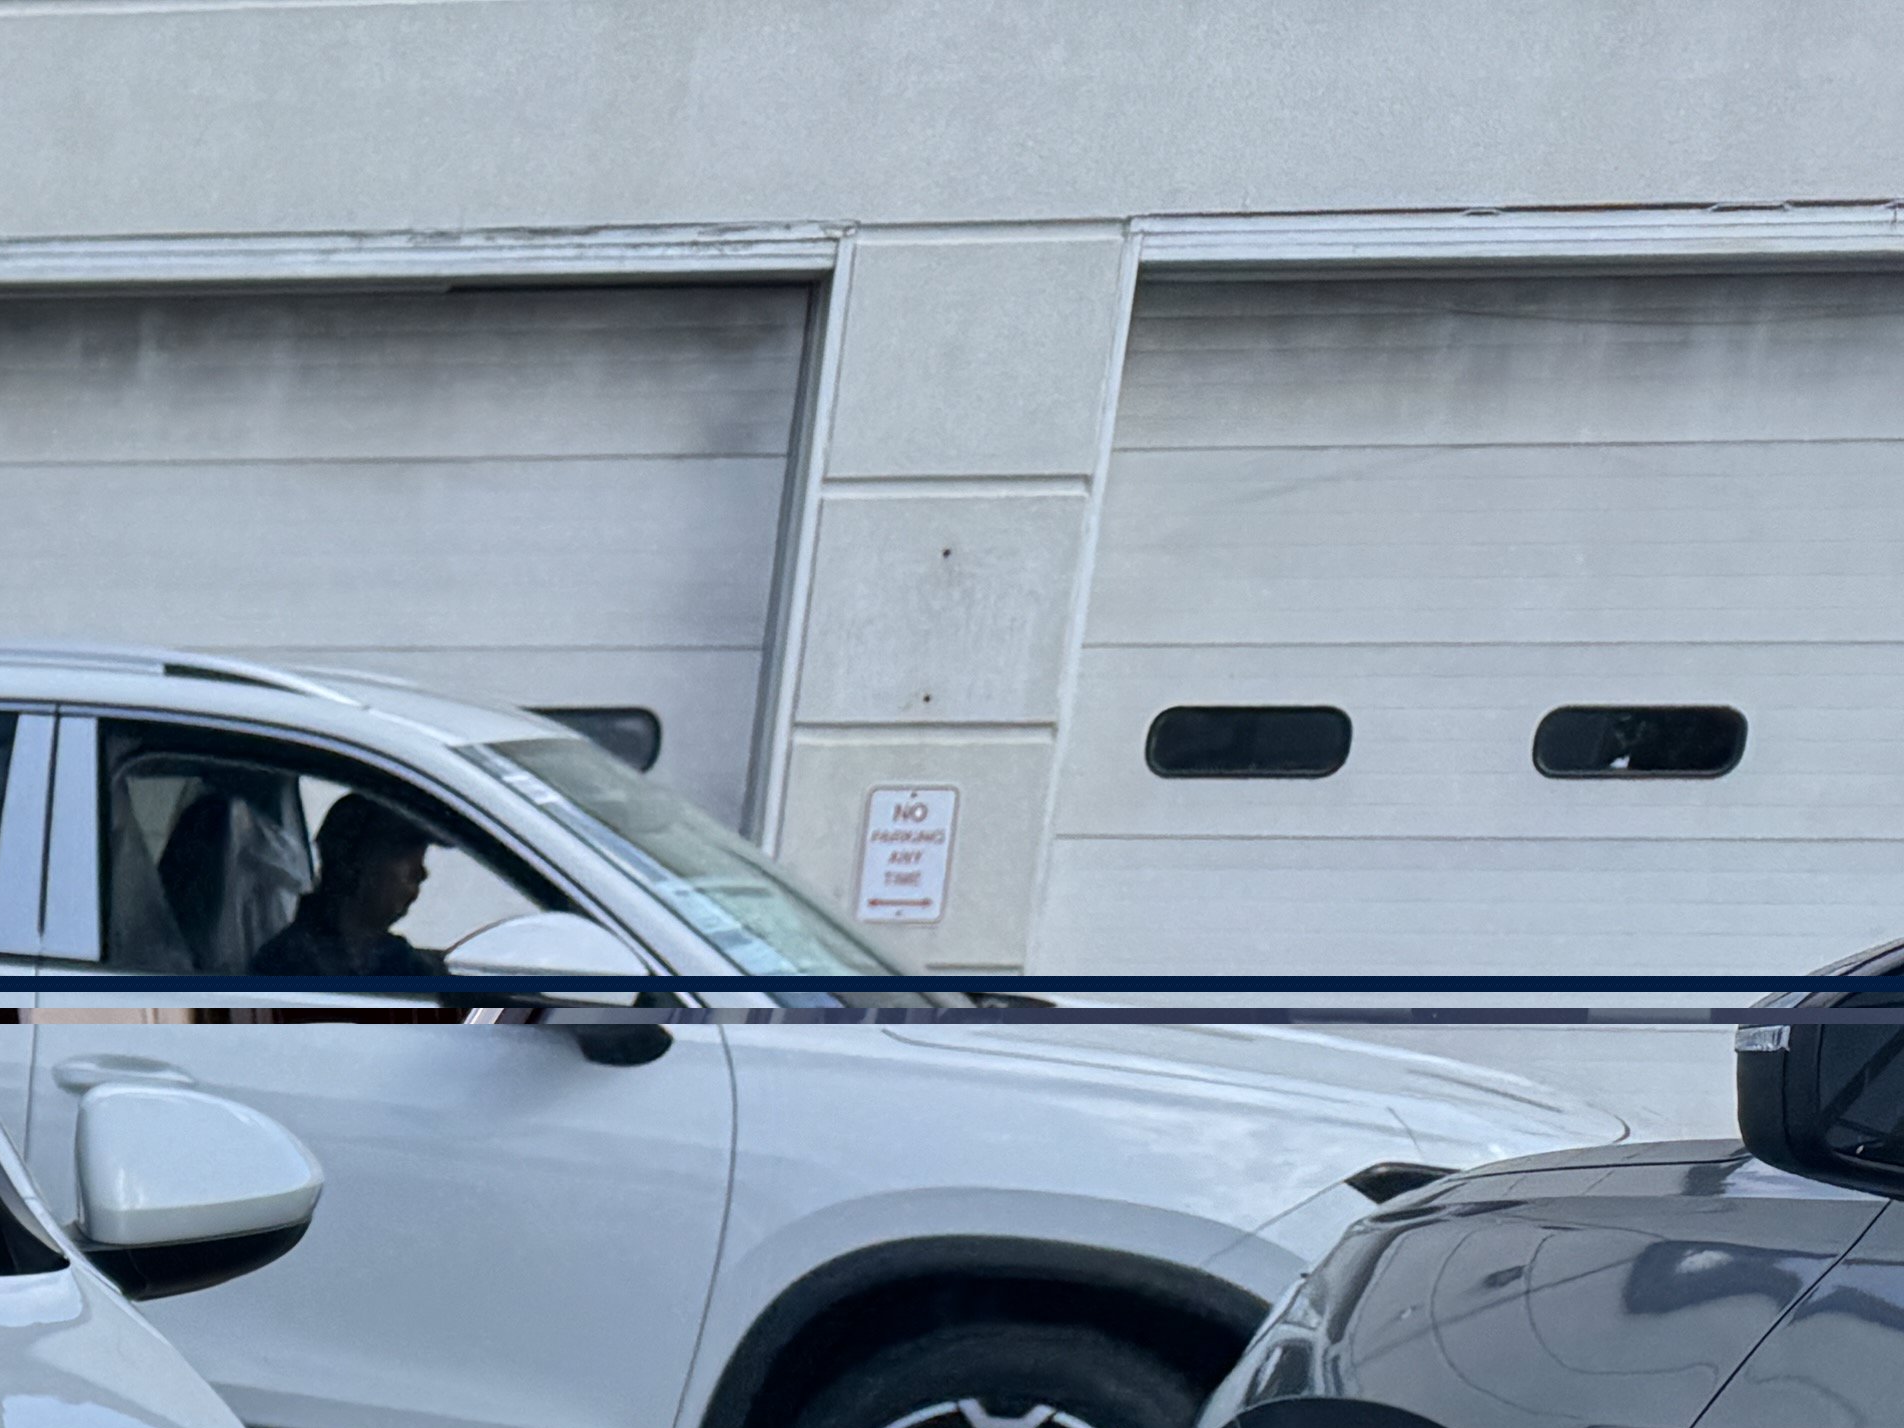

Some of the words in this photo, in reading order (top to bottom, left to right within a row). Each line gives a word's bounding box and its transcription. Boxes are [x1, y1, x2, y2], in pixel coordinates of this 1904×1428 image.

[892, 802, 929, 823] NO
[870, 828, 946, 845] PARKING
[888, 850, 924, 865] ANY
